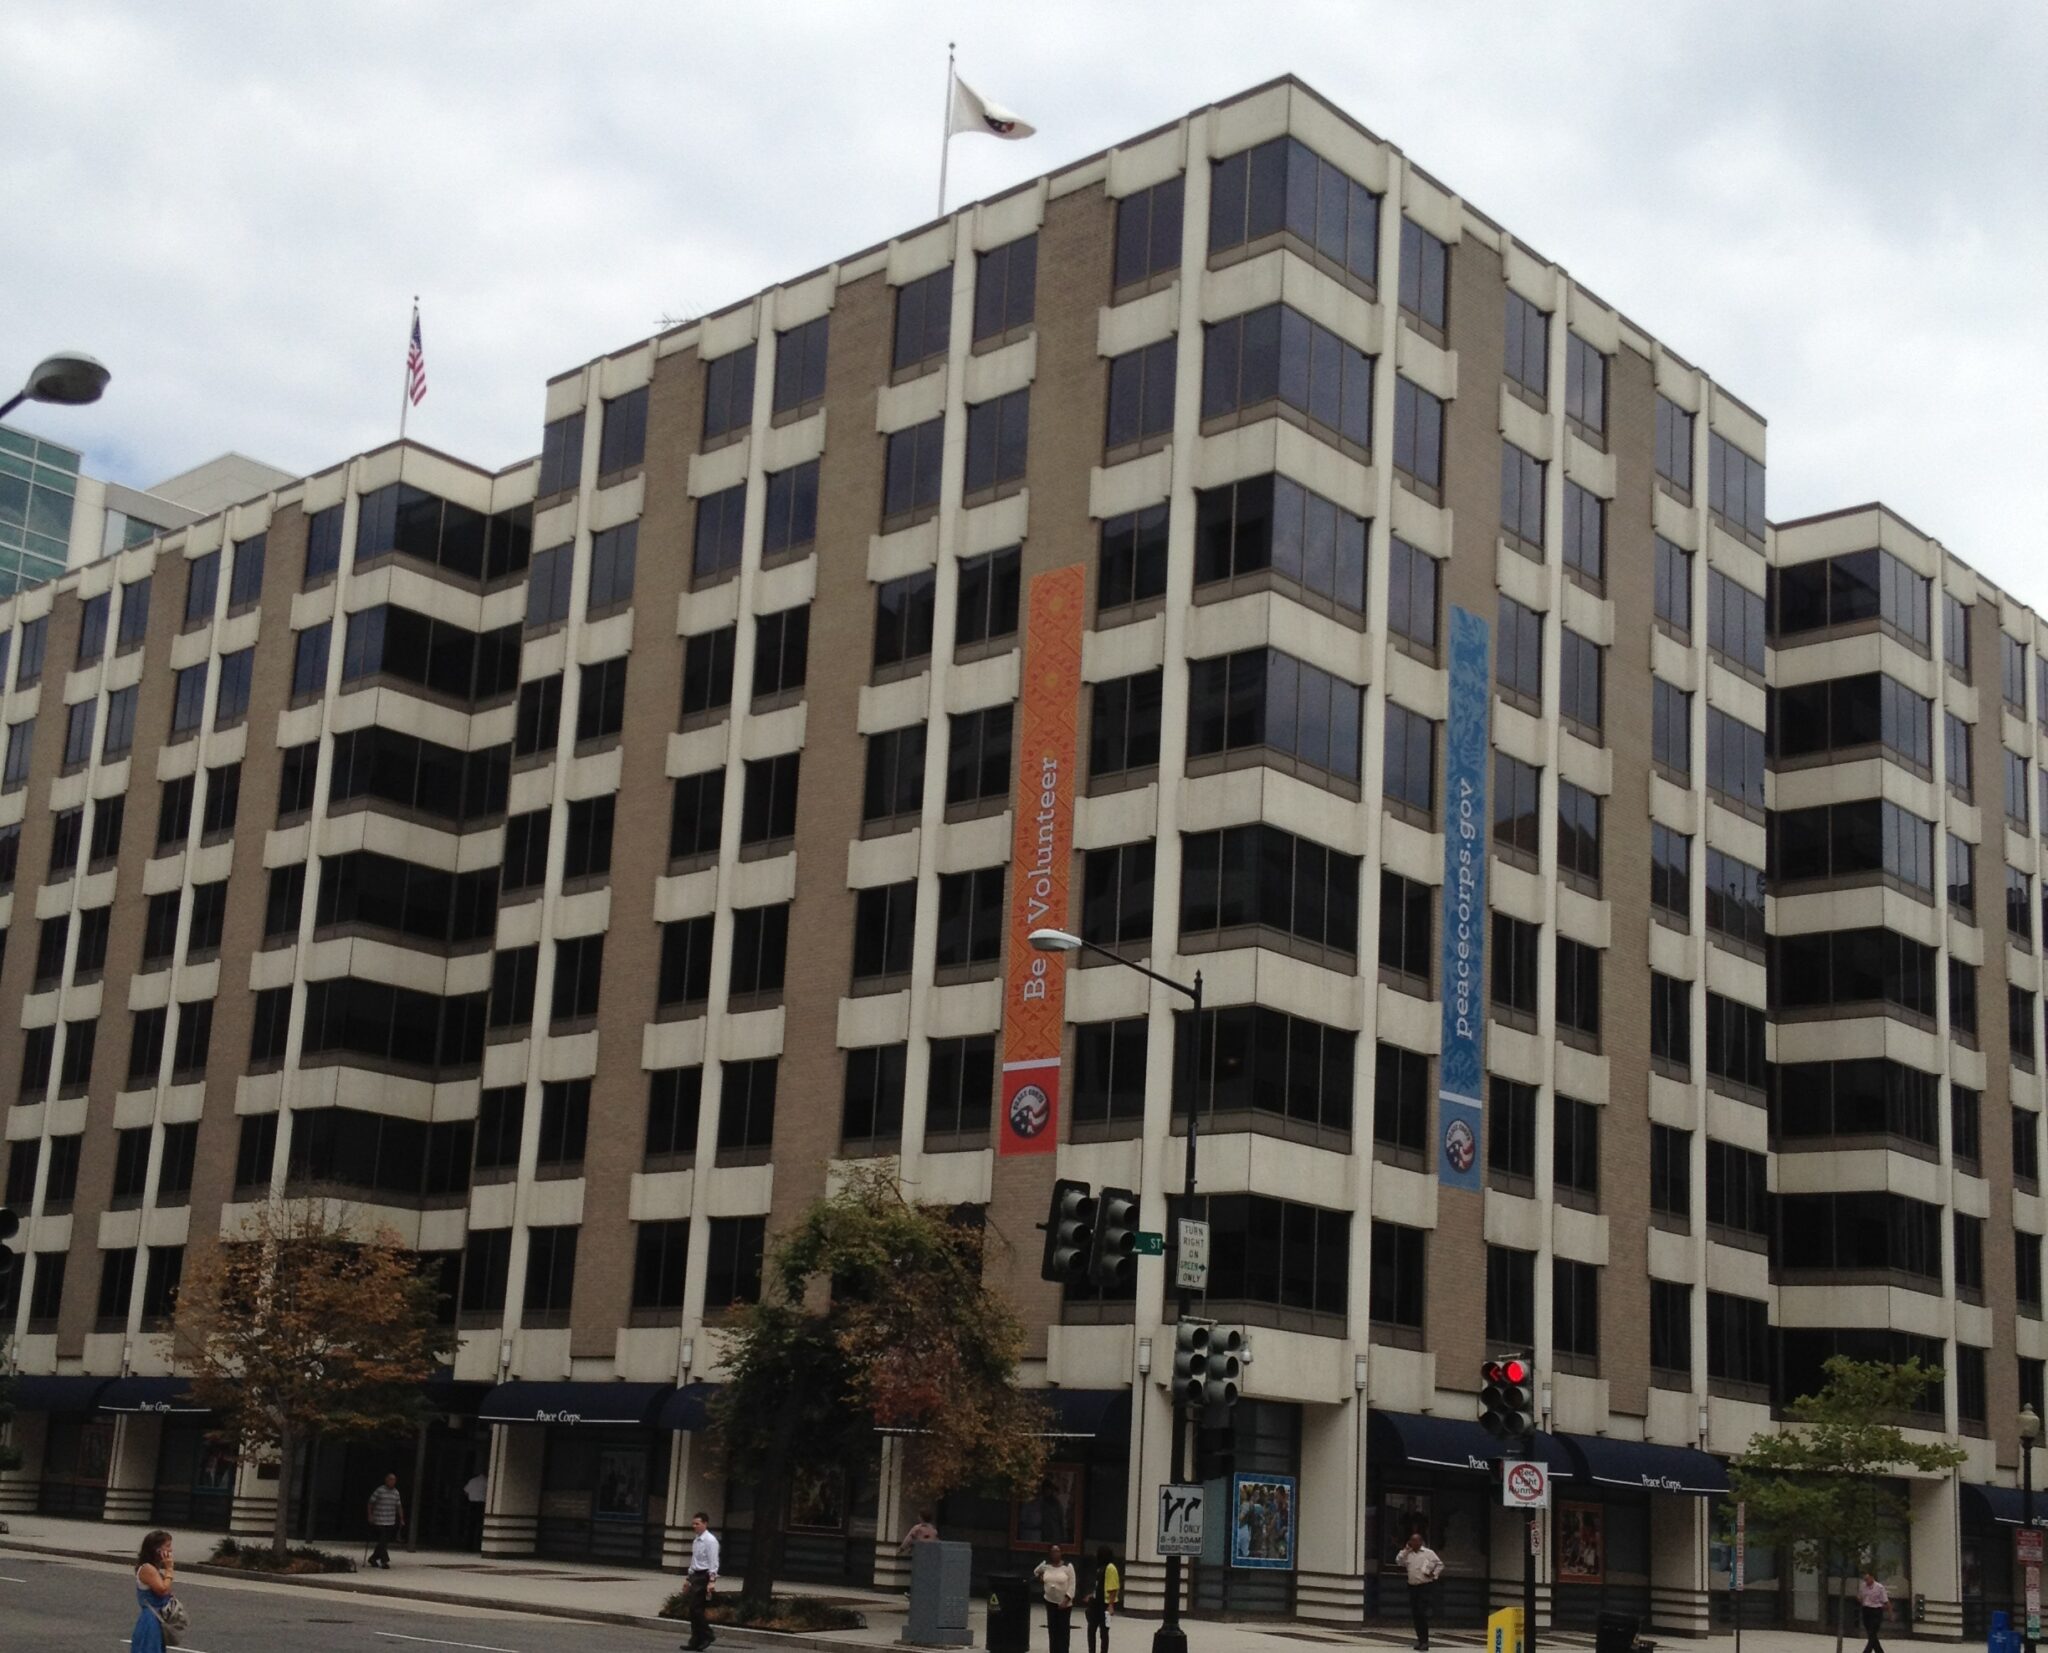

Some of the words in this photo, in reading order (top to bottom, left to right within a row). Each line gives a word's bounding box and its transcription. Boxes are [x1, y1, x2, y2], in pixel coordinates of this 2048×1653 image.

[1027, 757, 1057, 924] Volunteer
[1457, 777, 1475, 1041] peacecorps.gov
[1024, 958, 1047, 1001] Be
[1184, 1225, 1204, 1236] TURN
[1150, 1238, 1162, 1250] ST
[1183, 1237, 1204, 1248] RIGHT
[1188, 1250, 1199, 1259] ON
[1182, 1272, 1201, 1283] ONLY
[536, 1409, 557, 1421] Peace
[558, 1410, 580, 1425] Corps
[1468, 1454, 1490, 1471] Peace
[1642, 1473, 1660, 1488] Peace
[1661, 1476, 1681, 1492] Corps
